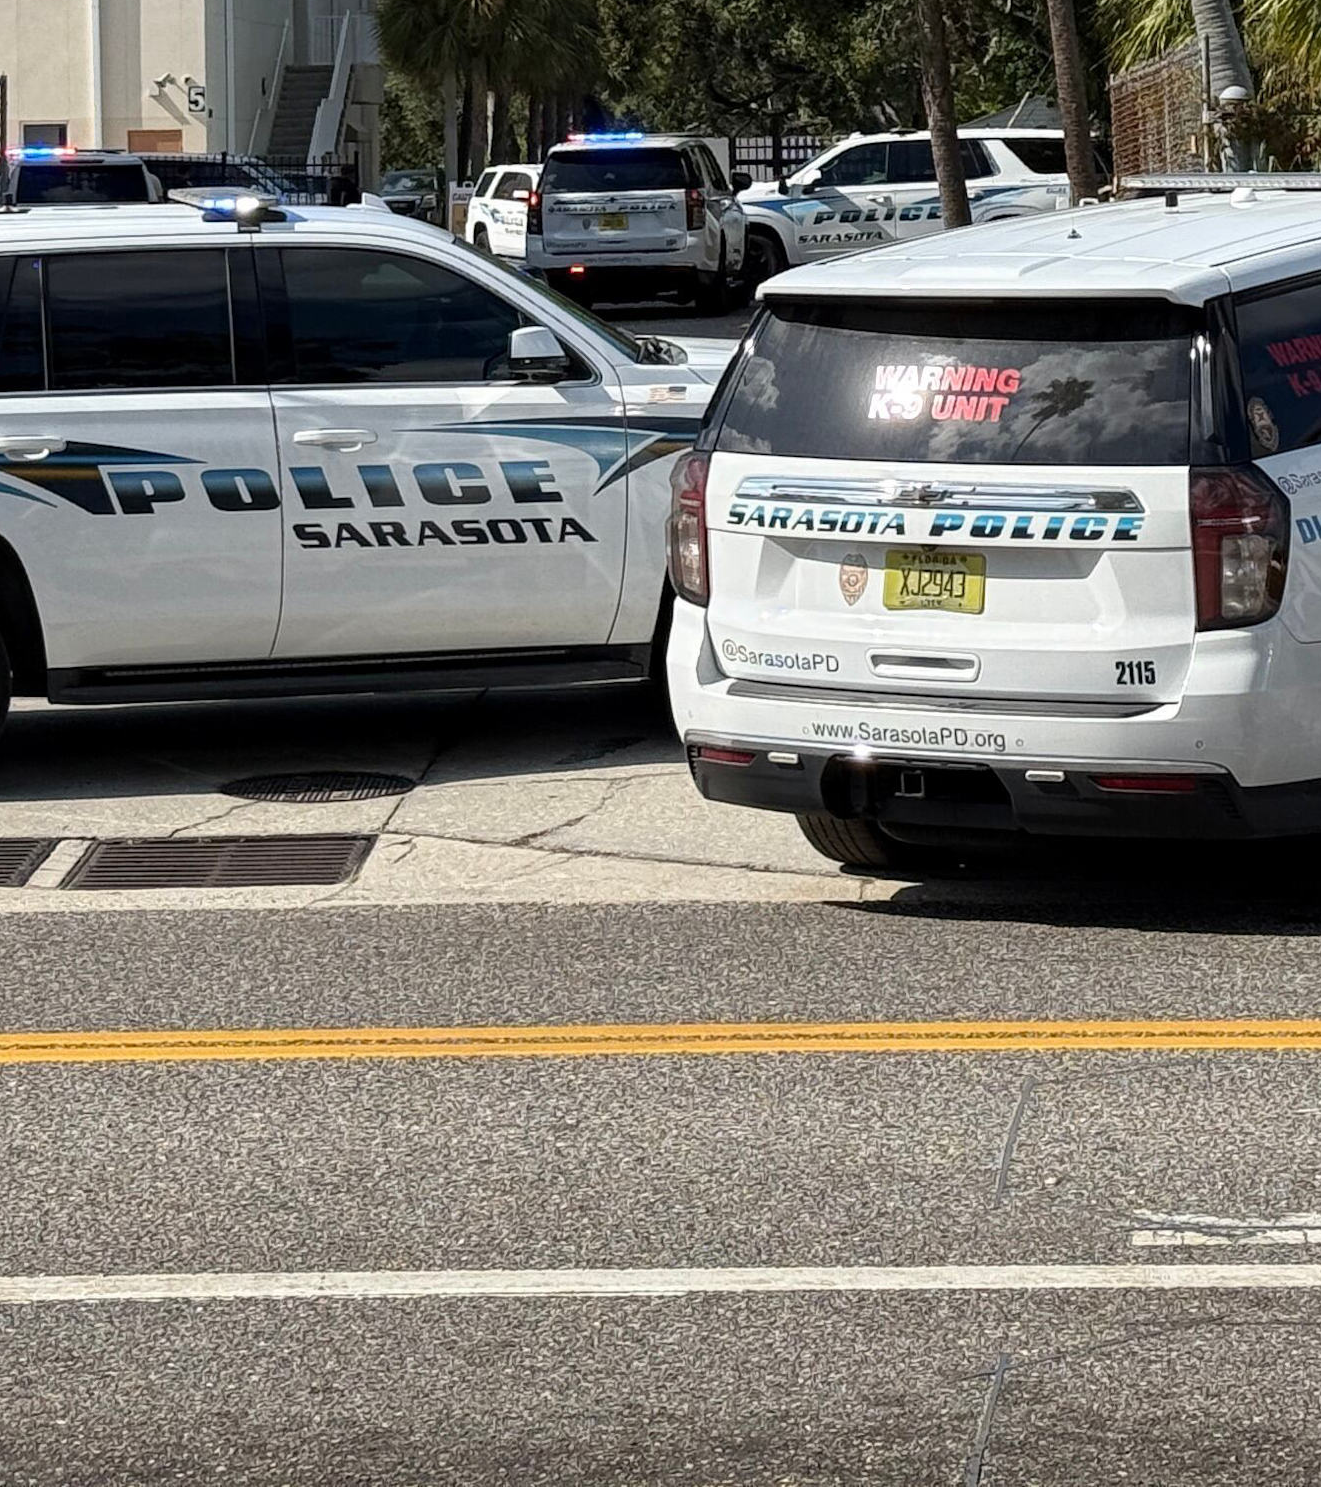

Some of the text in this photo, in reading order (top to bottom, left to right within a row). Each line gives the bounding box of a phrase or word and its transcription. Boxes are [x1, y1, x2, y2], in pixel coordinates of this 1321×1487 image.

[188, 87, 205, 112] 5
[797, 230, 884, 245] SARASOTA
[874, 364, 1022, 395] WARNING
[867, 392, 1010, 423] K-9 UNIT
[107, 459, 564, 515] POLICE
[291, 517, 599, 550] SARASOTA
[726, 503, 1146, 542] SARASOTA POLICE
[899, 567, 966, 599] XJ2943
[721, 638, 840, 673] @SarasotaPD
[1115, 660, 1157, 686] 2115
[811, 720, 1007, 753] www.SarasotaPD.org
